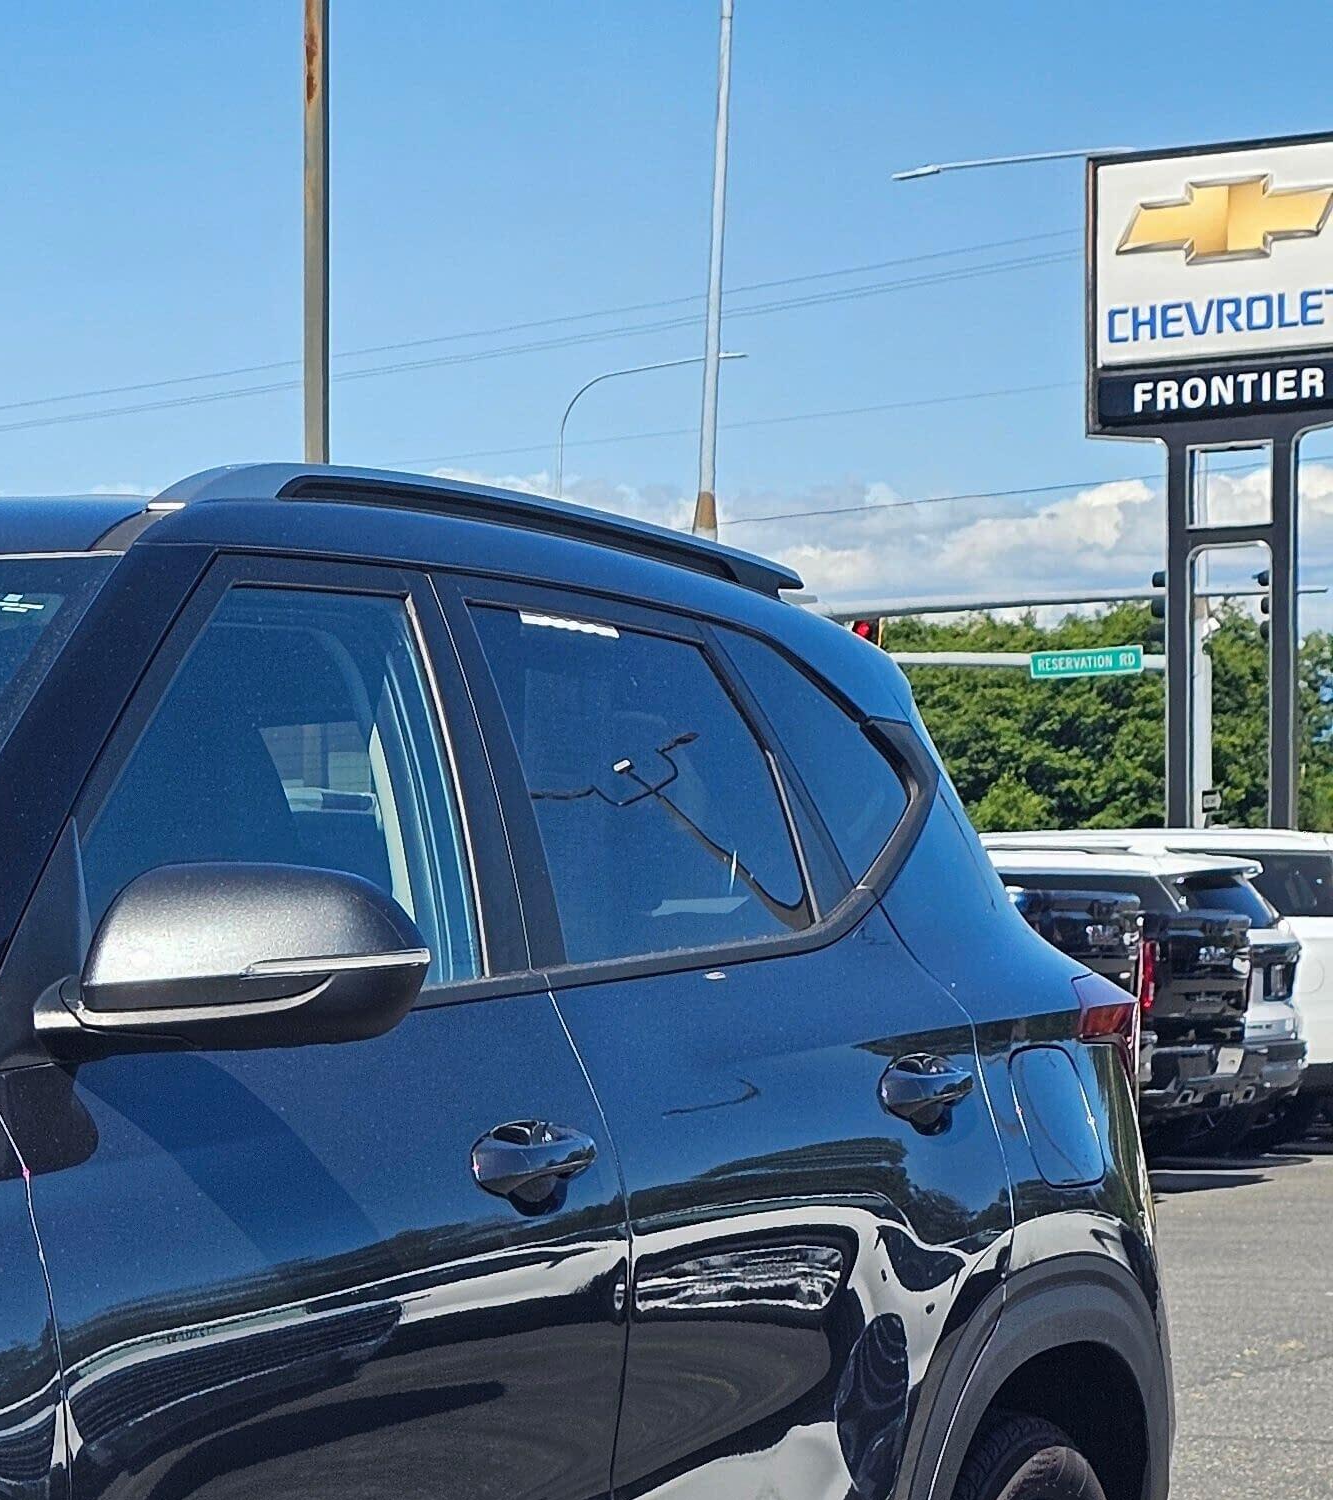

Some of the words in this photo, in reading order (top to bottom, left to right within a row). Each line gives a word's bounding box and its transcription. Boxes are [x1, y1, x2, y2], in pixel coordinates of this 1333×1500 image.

[1134, 368, 1324, 413] FRONTIER
[1038, 655, 1113, 671] RESERVATION
[1119, 652, 1136, 667] RD
